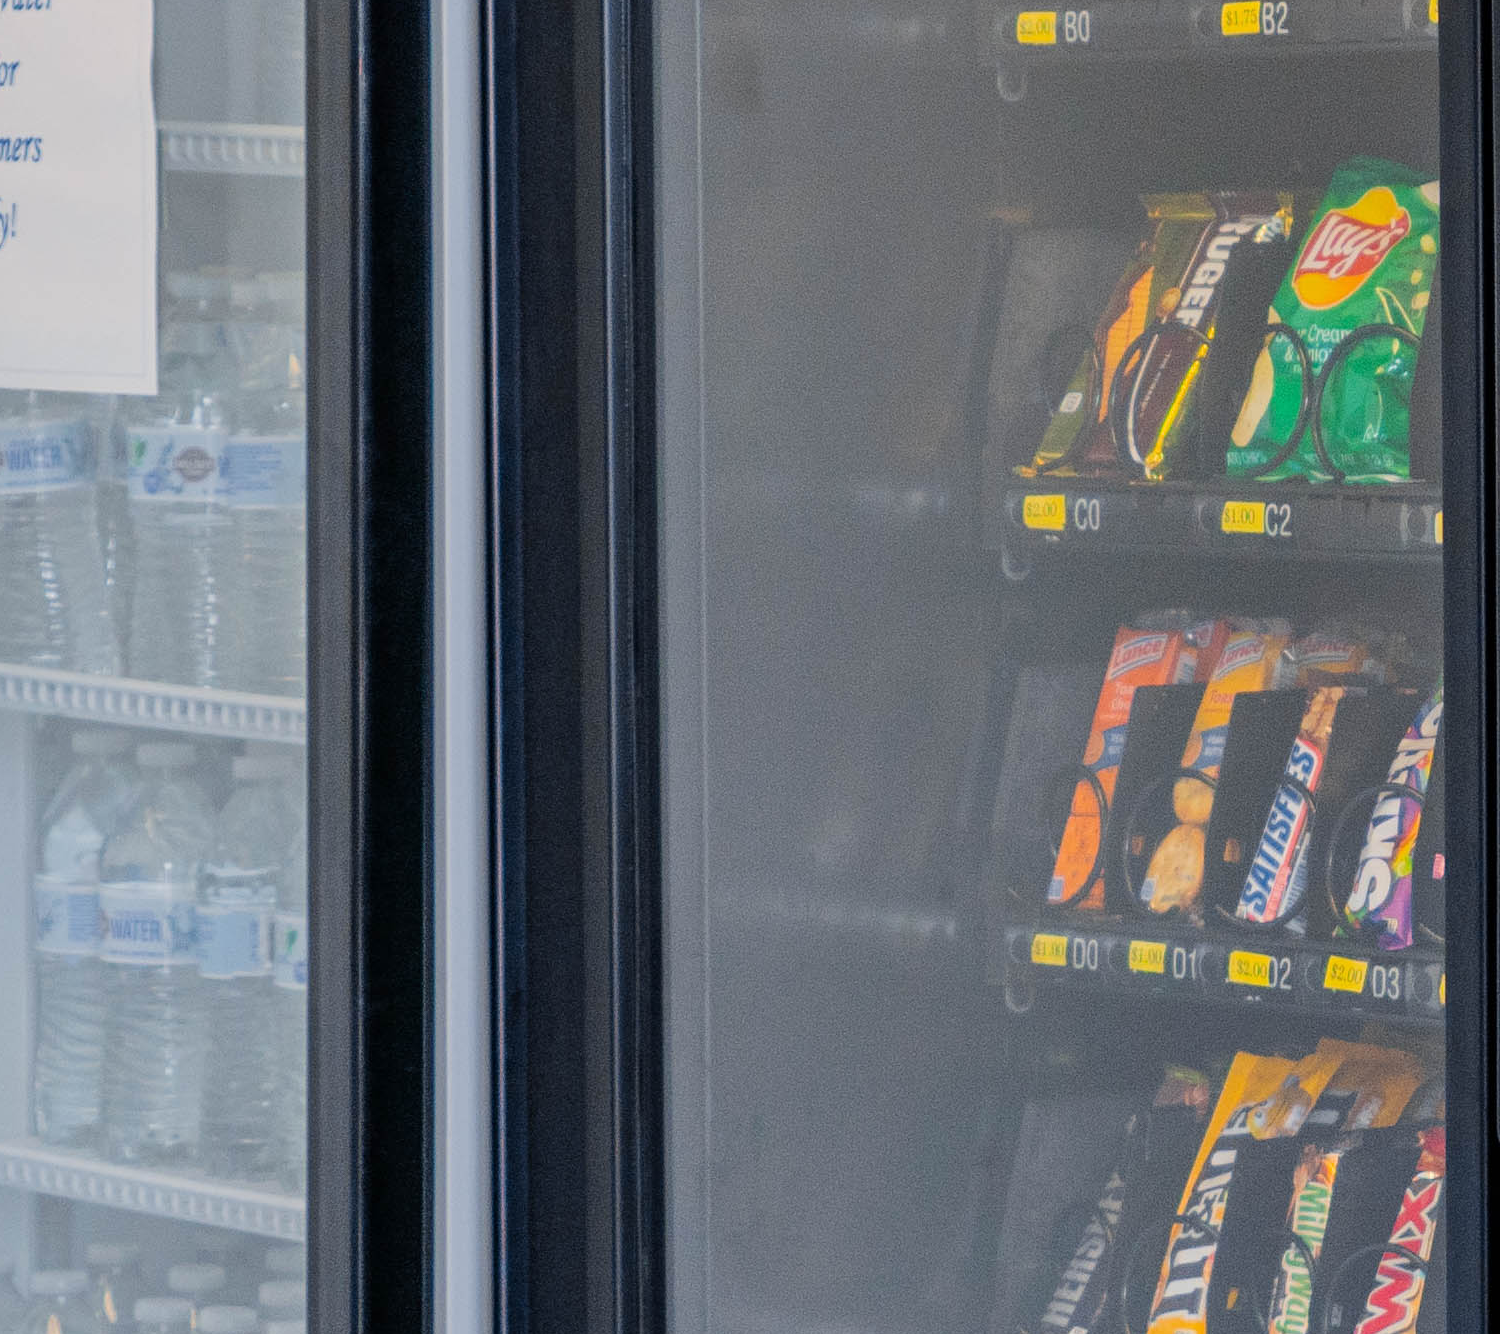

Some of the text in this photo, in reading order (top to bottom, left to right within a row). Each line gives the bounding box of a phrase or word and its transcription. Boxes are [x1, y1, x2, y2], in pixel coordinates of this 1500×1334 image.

[1064, 10, 1091, 43] B0
[1262, 2, 1290, 36] B2
[1301, 211, 1406, 279] Lay's
[1074, 498, 1101, 530] C0
[1265, 503, 1292, 537] C2
[1072, 938, 1099, 972] D0
[1173, 947, 1198, 981] D1
[1236, 959, 1268, 979] $2.00
[1330, 965, 1364, 986] $2.00
[1372, 966, 1400, 1001] D3
